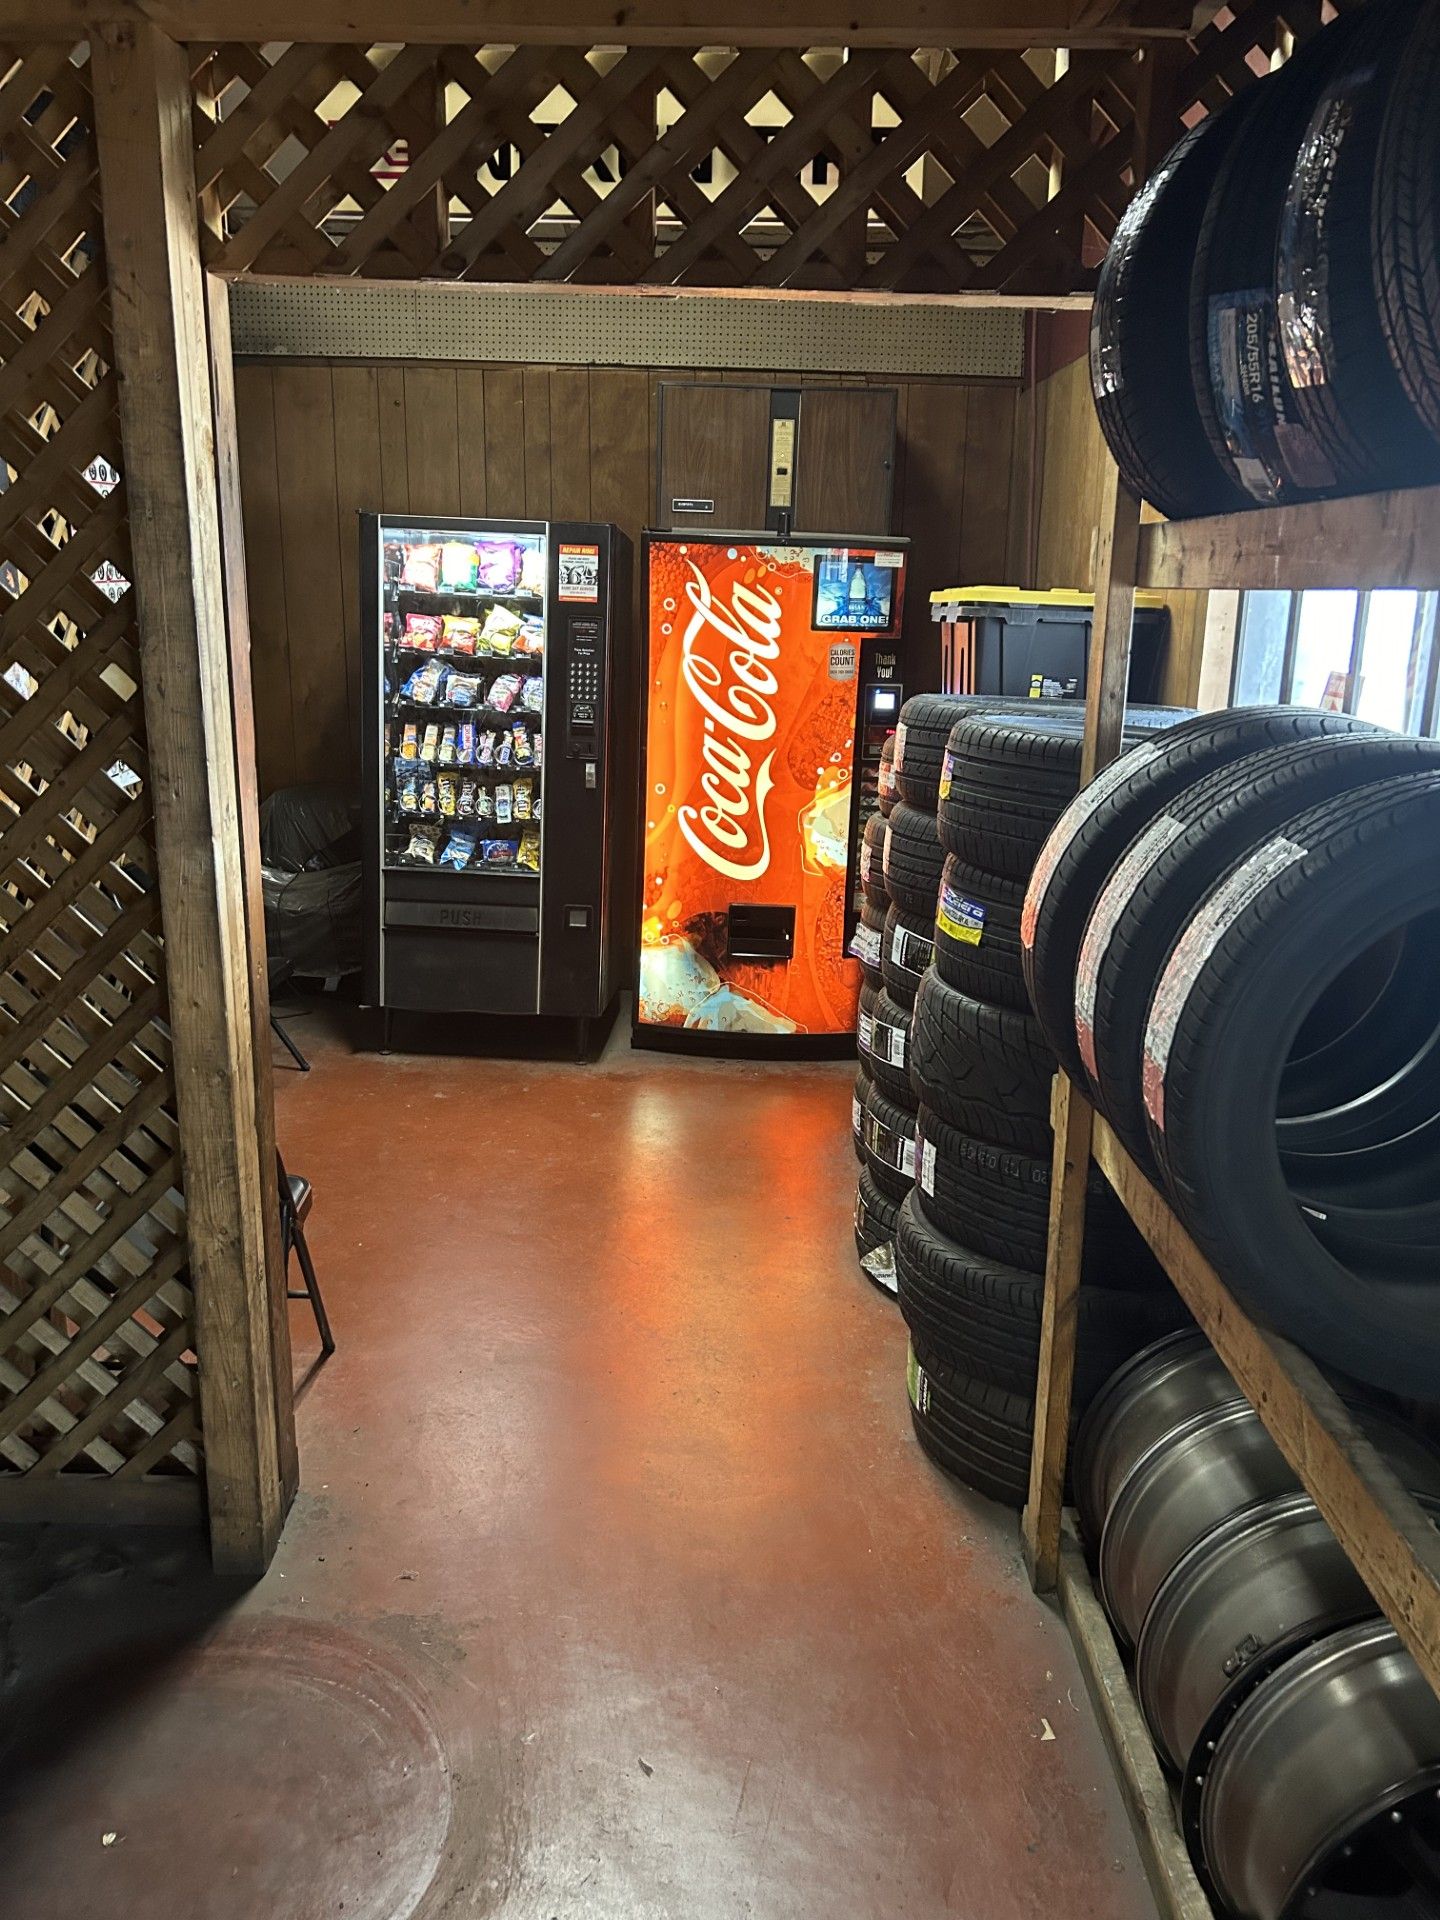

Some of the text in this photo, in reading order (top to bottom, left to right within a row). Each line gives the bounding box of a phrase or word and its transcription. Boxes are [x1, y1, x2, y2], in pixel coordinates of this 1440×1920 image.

[1246, 313, 1265, 403] 205/55R16
[822, 614, 889, 624] GRAB ONE!
[830, 656, 855, 666] COUNT
[875, 652, 896, 665] Thank
[678, 558, 782, 881] Coca-Cola
[439, 908, 482, 926] PUSH
